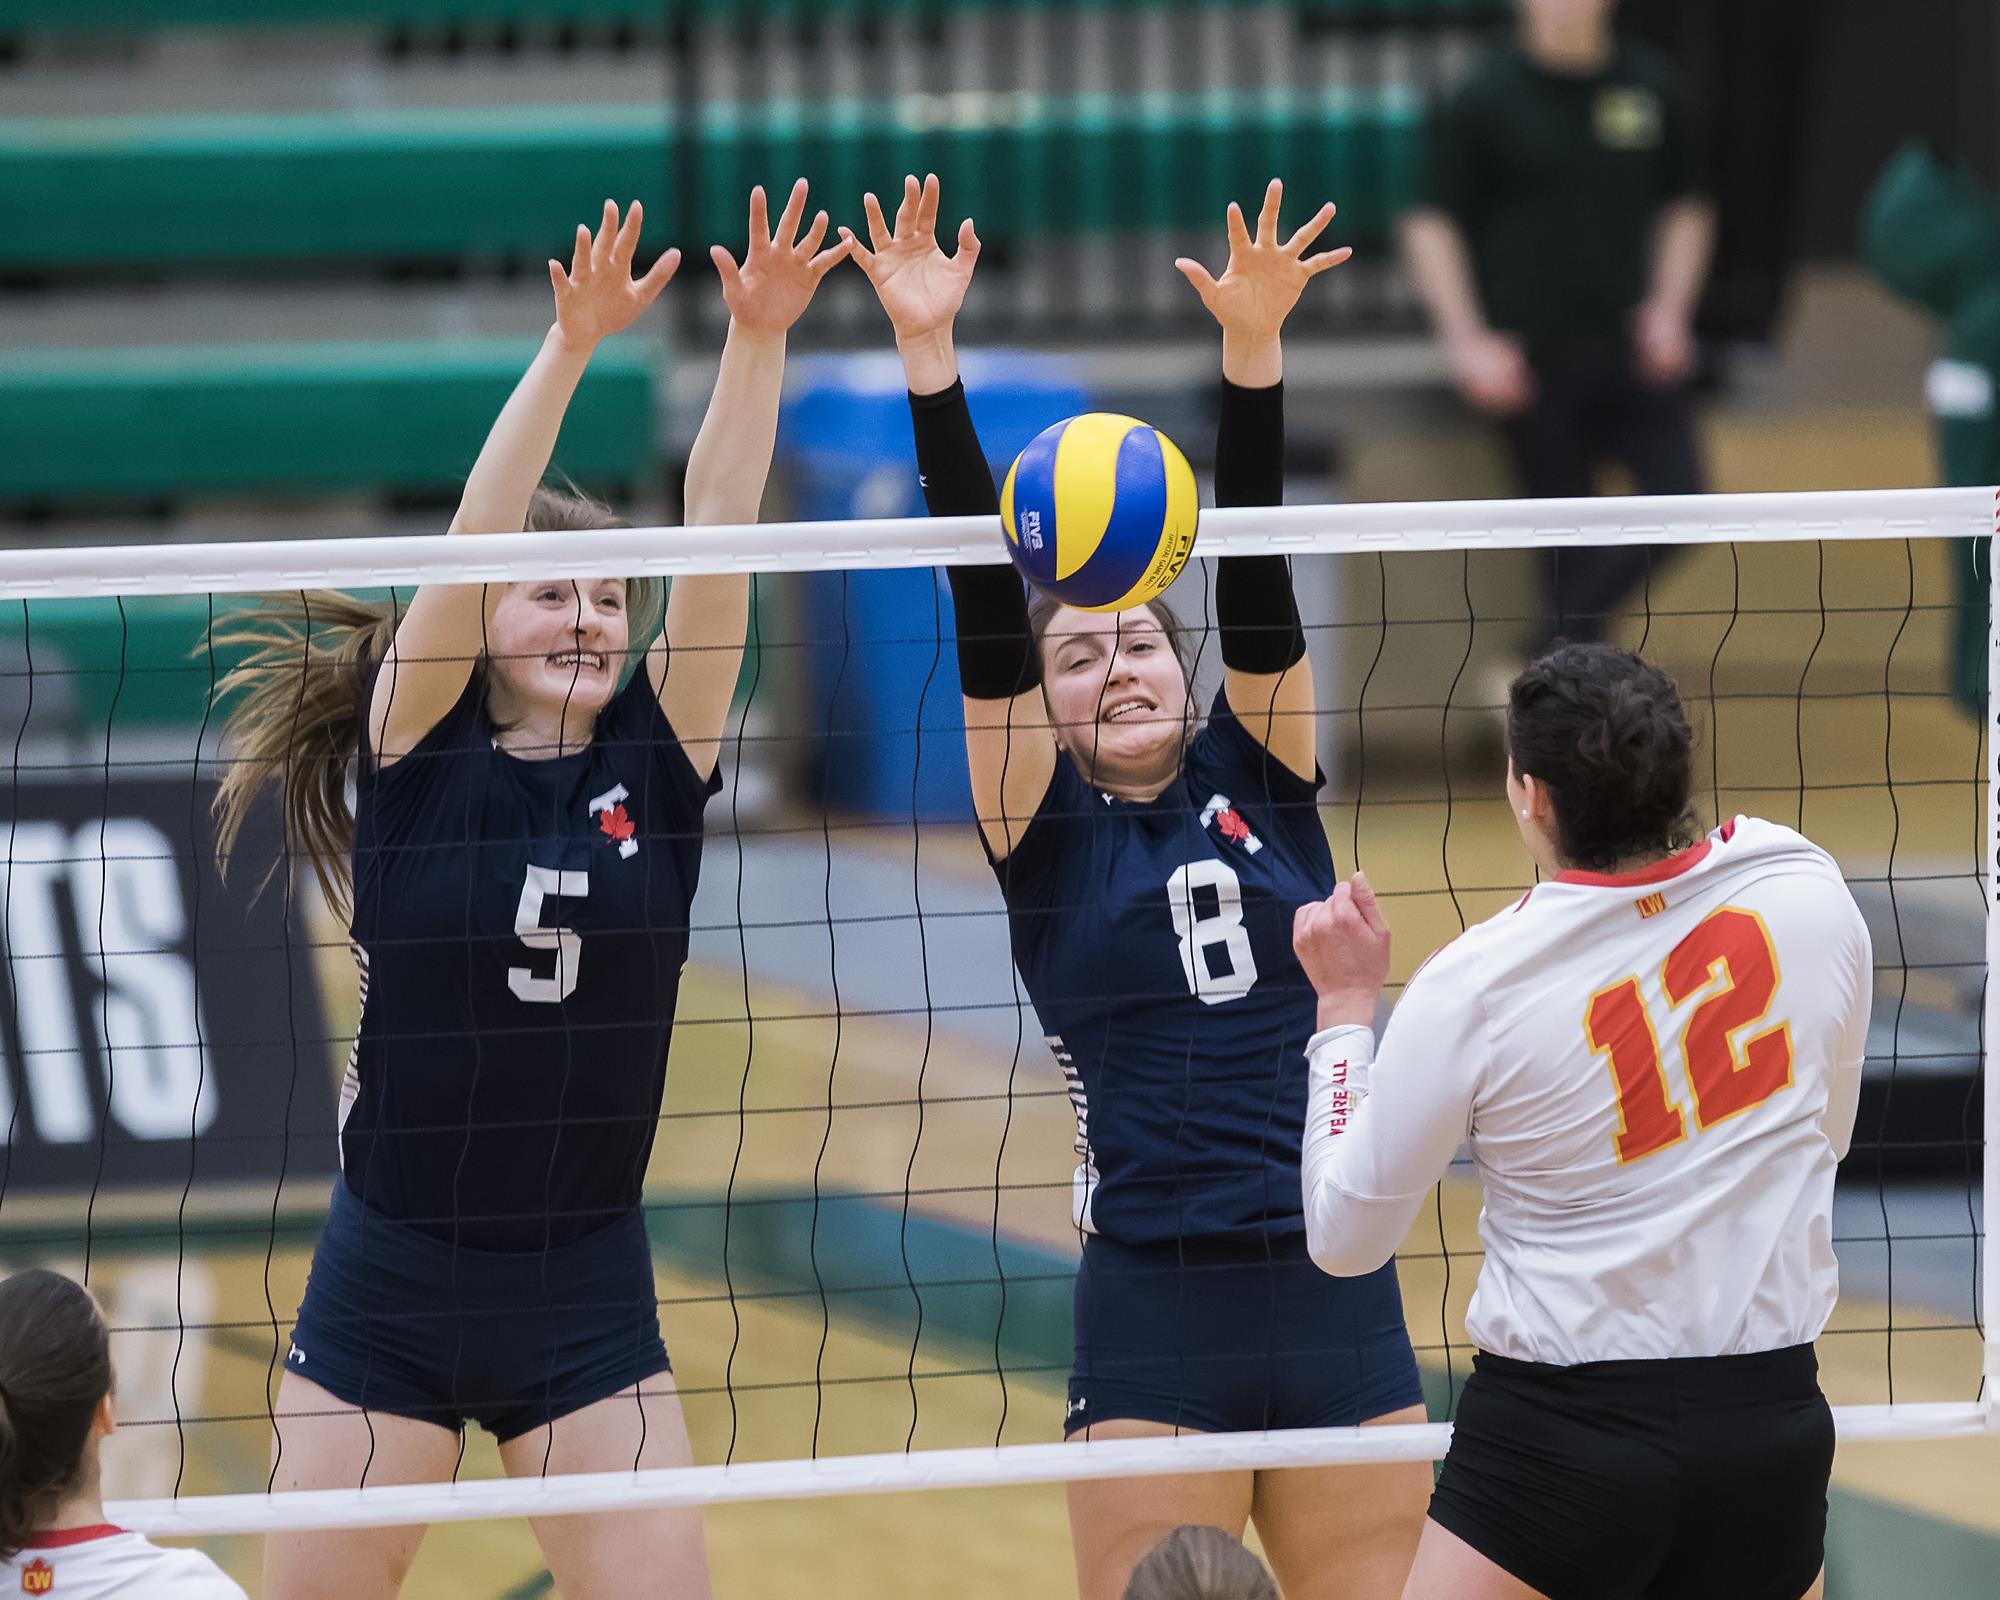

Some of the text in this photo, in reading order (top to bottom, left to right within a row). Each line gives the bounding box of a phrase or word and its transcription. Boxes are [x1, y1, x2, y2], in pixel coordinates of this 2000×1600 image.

[0, 818, 220, 1145] TS
[507, 863, 589, 1004] 5
[1166, 858, 1259, 1006] 8
[1331, 1059, 1348, 1085] ALL
[1581, 905, 1797, 1168] 12
[23, 1571, 53, 1590] CW
